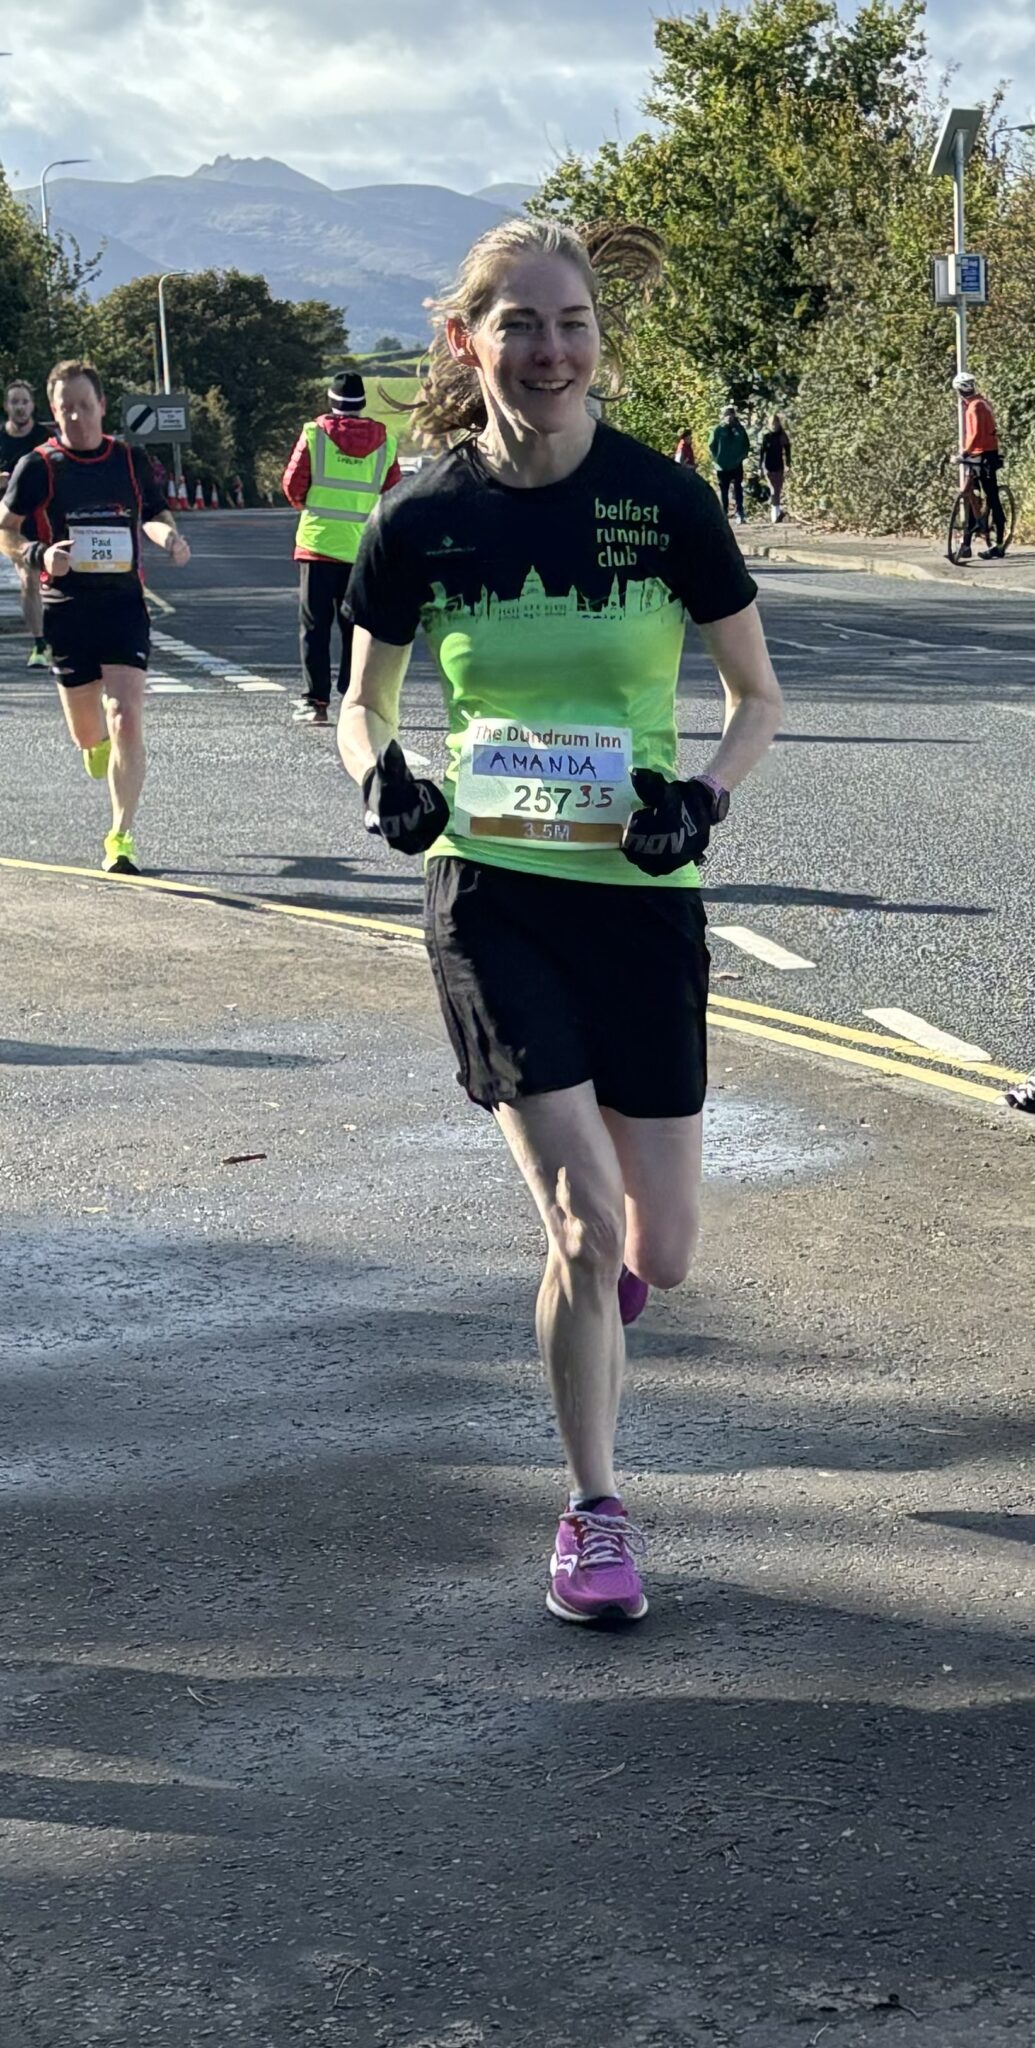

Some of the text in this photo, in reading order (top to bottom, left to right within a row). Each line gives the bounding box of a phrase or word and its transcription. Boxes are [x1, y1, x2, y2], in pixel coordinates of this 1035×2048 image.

[595, 497, 659, 524] belfast
[596, 524, 670, 551] running
[598, 545, 637, 568] club
[475, 724, 622, 749] The Dundrum Inn
[489, 750, 597, 780] AMANDA
[513, 785, 572, 815] 257
